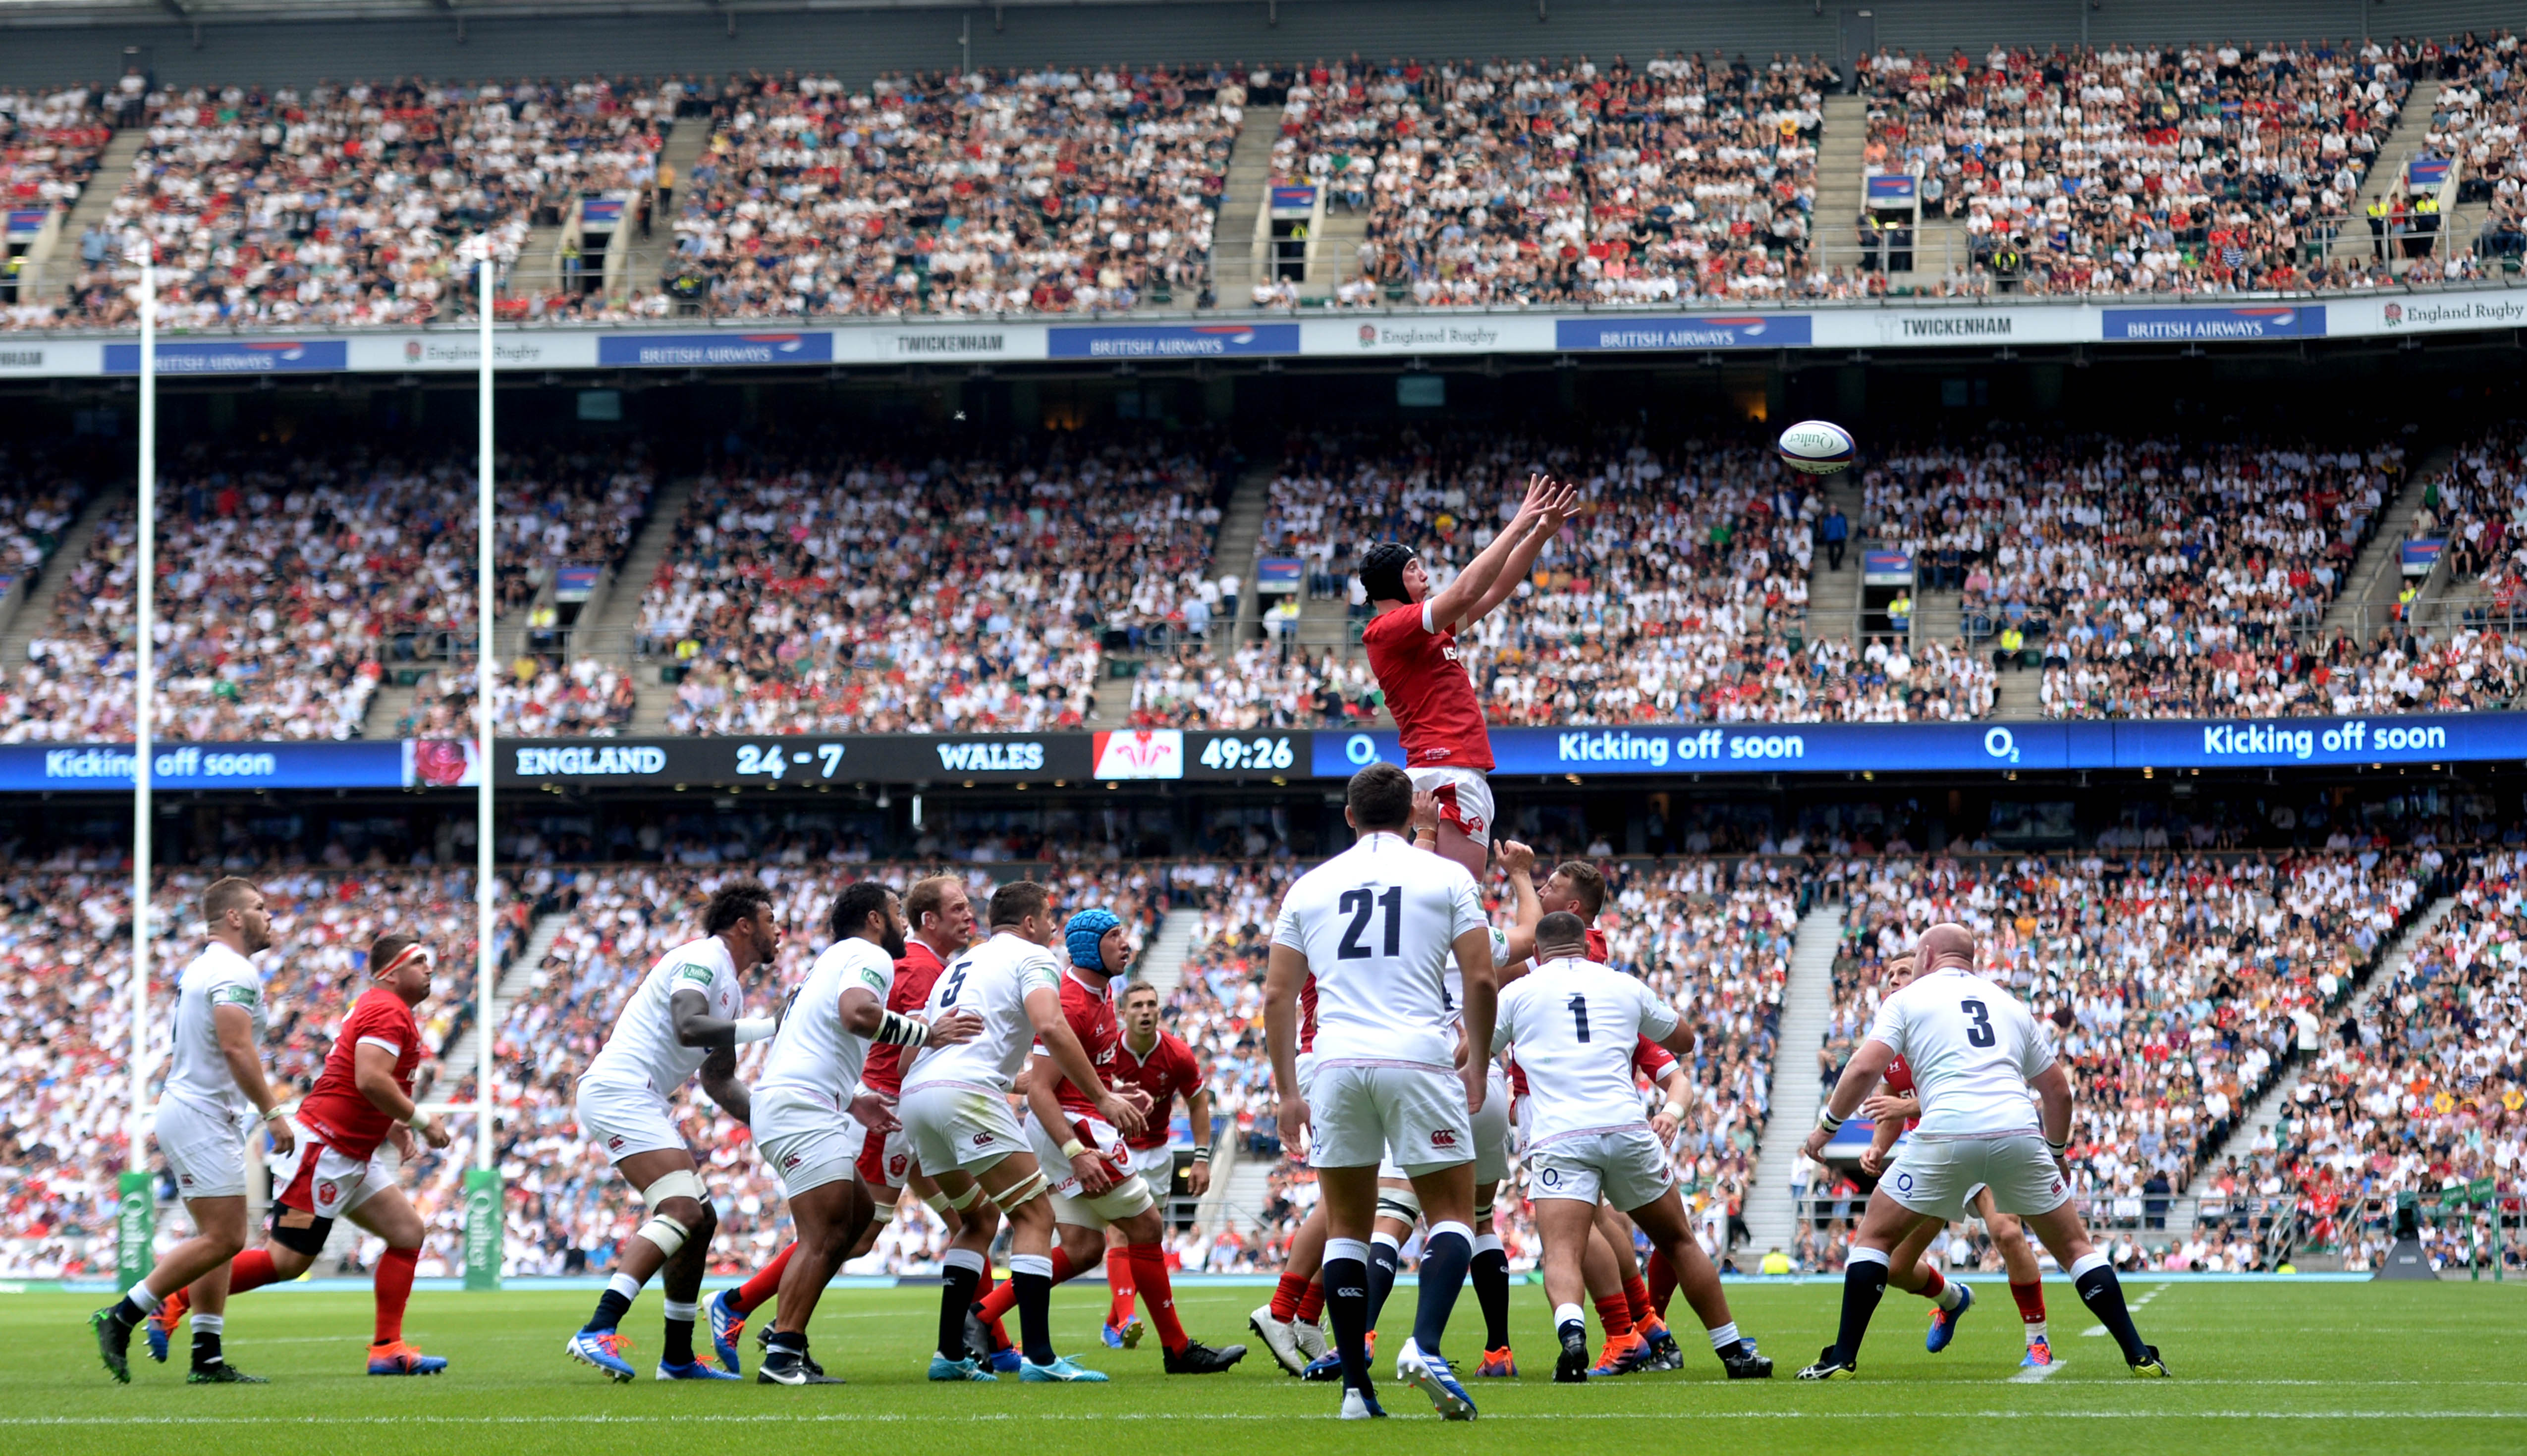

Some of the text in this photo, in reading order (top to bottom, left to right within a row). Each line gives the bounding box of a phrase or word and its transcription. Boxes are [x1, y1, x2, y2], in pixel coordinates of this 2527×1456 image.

[2408, 301, 2525, 322] England Rugby
[1381, 328, 1498, 347] England Rugby
[1600, 330, 1734, 348] BRITISH AIRWAYS
[1902, 317, 2012, 337] TWICKENHAM
[2127, 320, 2263, 338] BRITISH AIRWAYS
[427, 346, 480, 363] Englan
[640, 347, 772, 364] BRITISH AIRWAYS
[897, 335, 1003, 353] TWICKENHAM
[1090, 337, 1223, 356] BRITISH AIRWAYS
[154, 353, 274, 372] RITISH AIRWAYS
[1788, 432, 1833, 450] Quilter
[1442, 647, 1457, 660] IS
[1559, 729, 1804, 766] Kicking off soon
[2204, 721, 2446, 760] Kicking off soon
[155, 747, 203, 776] off
[204, 752, 275, 776] soon
[516, 747, 665, 775] ENGLAND
[937, 743, 1044, 770] WALES
[1200, 738, 1294, 769] 49:26
[1338, 887, 1402, 960] 21
[940, 962, 972, 1008] 5
[1568, 997, 1590, 1043] 1
[1961, 1000, 1995, 1047] 3
[118, 1191, 147, 1272] Quilter
[466, 1190, 495, 1270] Quilter
